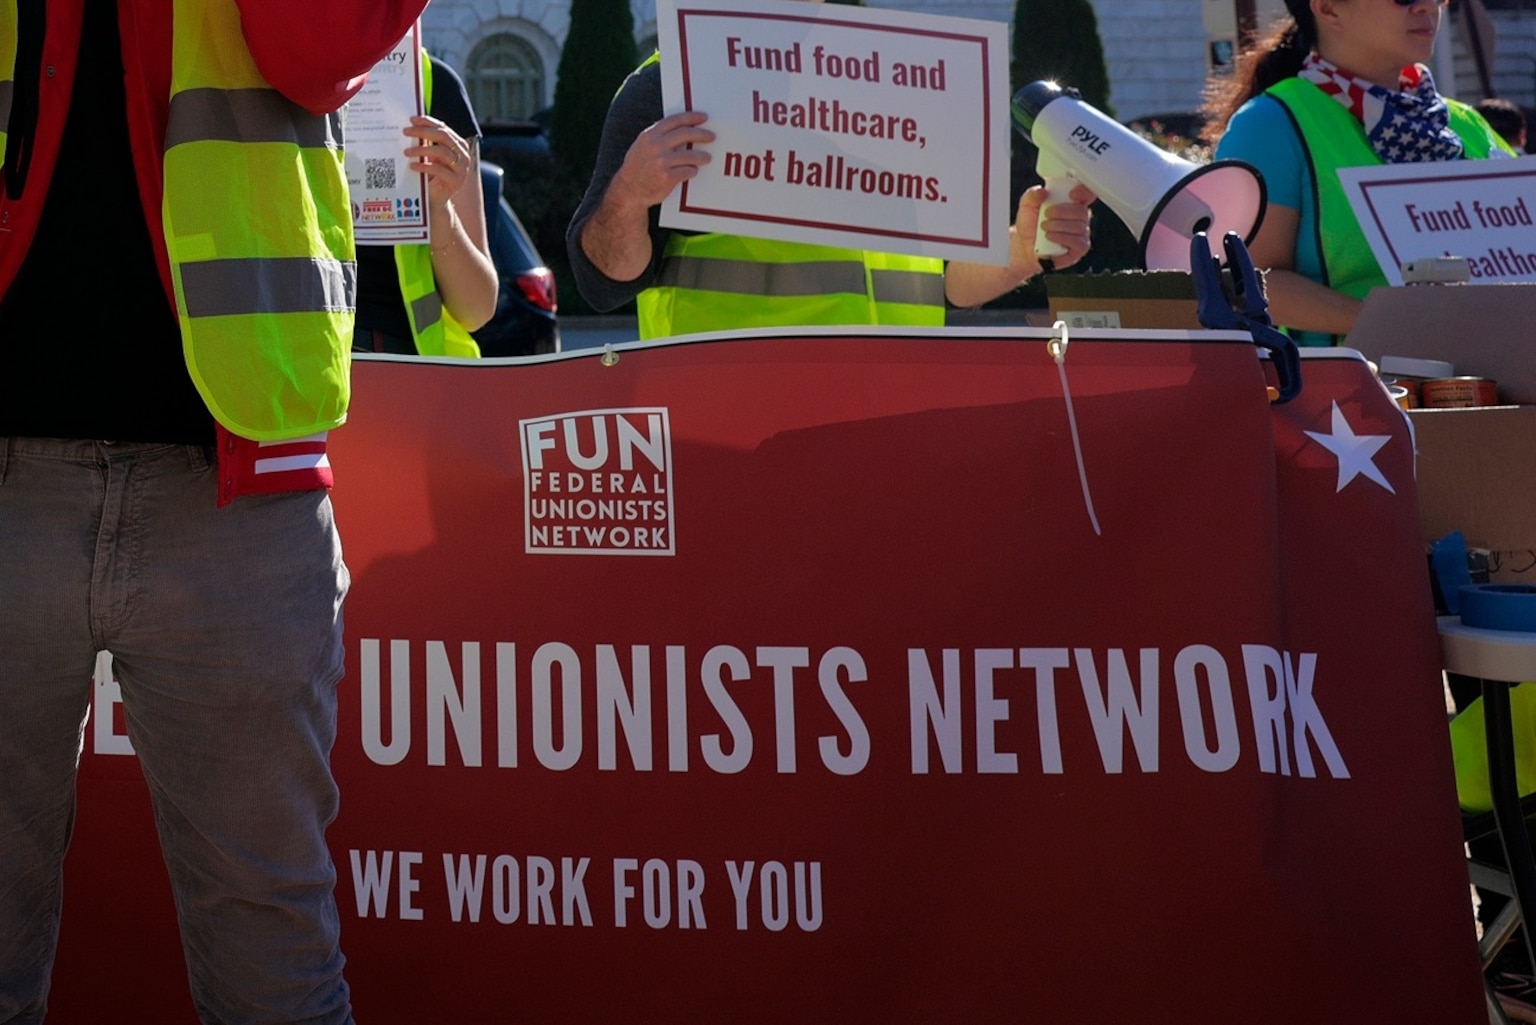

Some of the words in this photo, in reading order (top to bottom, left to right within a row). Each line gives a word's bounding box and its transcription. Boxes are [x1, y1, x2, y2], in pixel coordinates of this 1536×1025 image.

[726, 36, 802, 74] Fund
[812, 45, 881, 83] food
[892, 59, 946, 92] and
[752, 90, 927, 149] healthcare,
[723, 149, 775, 182] not
[786, 149, 948, 203] ballrooms.
[1405, 201, 1471, 233] Fund
[1473, 197, 1533, 228] food
[1444, 247, 1536, 278] ealthc
[526, 414, 664, 472] FUN
[531, 472, 665, 494] FEDERAL
[531, 498, 666, 521] UNIONISTS
[532, 525, 666, 548] NETWORK
[359, 637, 871, 775] UNIONISTS
[907, 643, 1351, 780] NETWORK
[349, 848, 424, 921] WE
[441, 852, 593, 929] WORK
[614, 858, 707, 932] FOR
[727, 859, 825, 933] YOU
